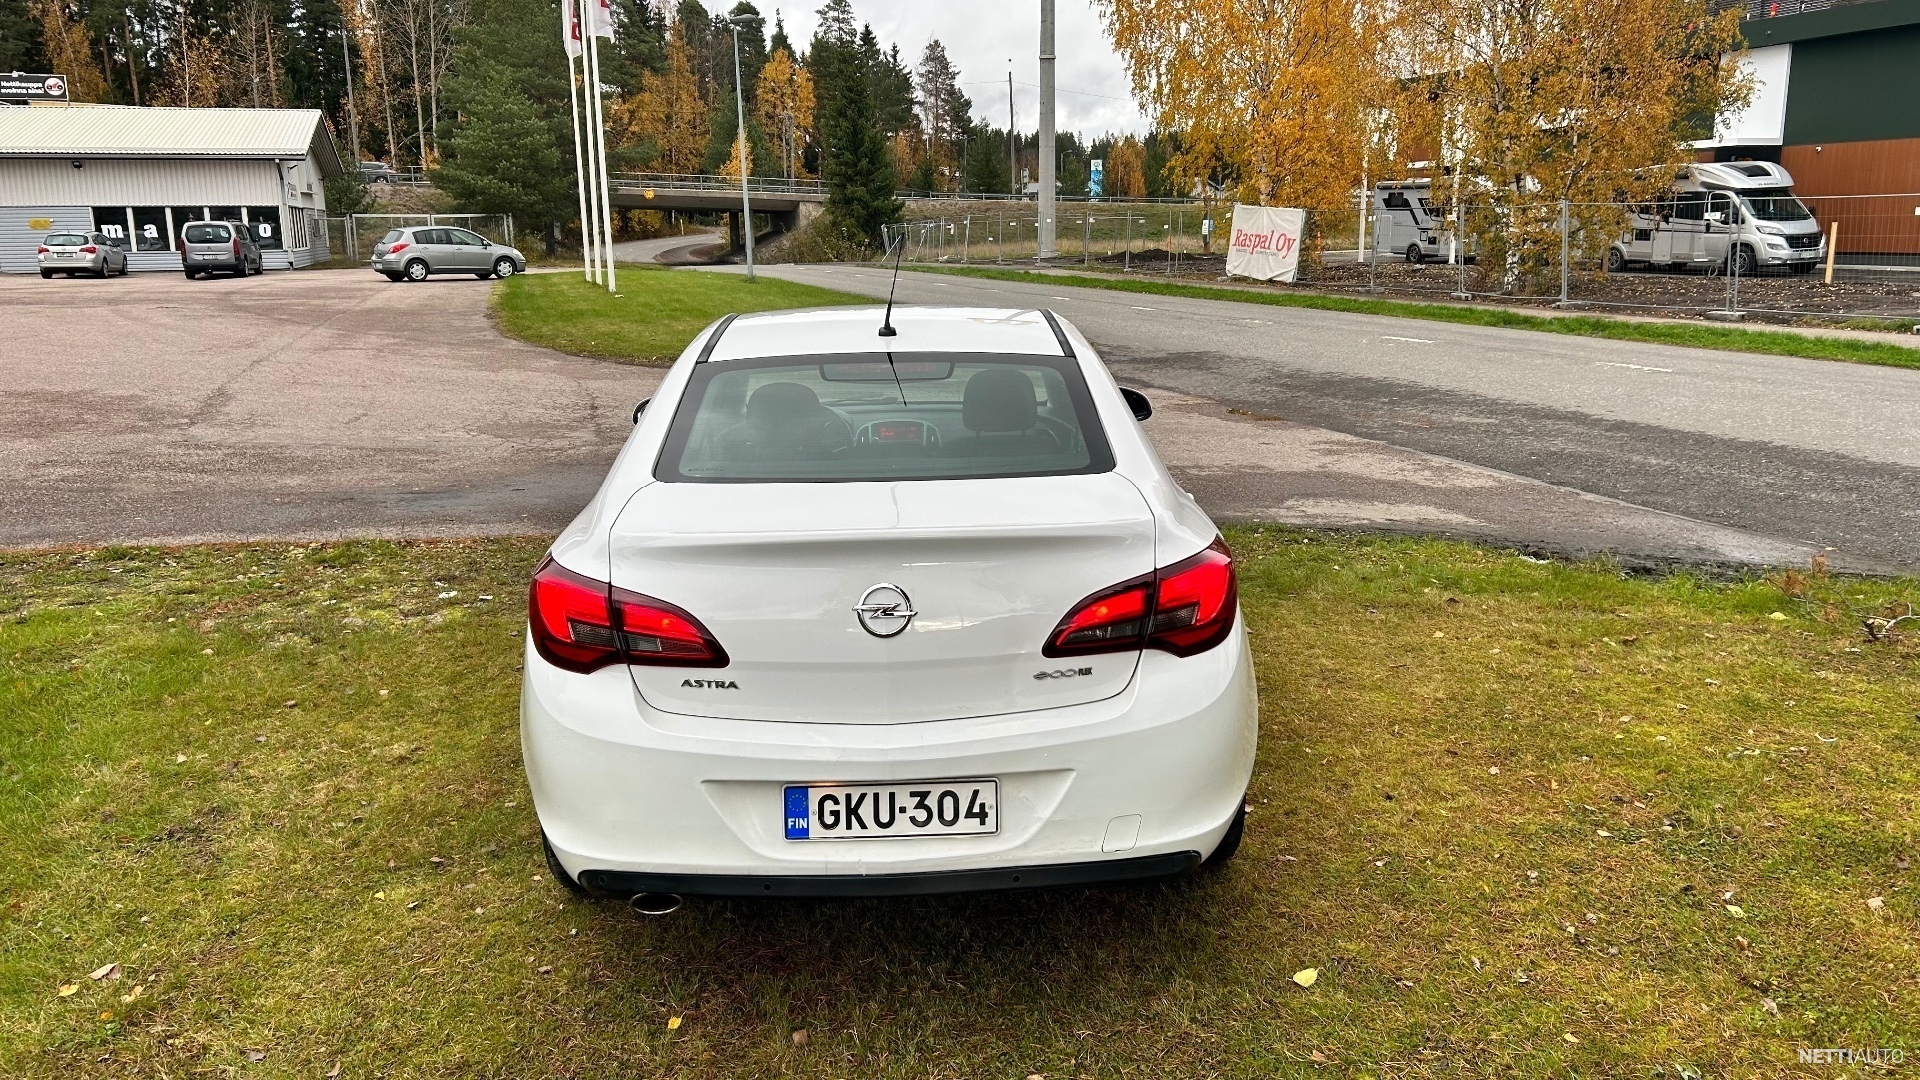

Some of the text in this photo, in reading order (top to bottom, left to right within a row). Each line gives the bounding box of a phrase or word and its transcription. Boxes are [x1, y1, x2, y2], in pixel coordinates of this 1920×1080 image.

[1232, 229, 1296, 259] Raspal Oy
[680, 679, 741, 690] ASTRA
[817, 789, 989, 831] GKU-304
[788, 818, 808, 829] FIN
